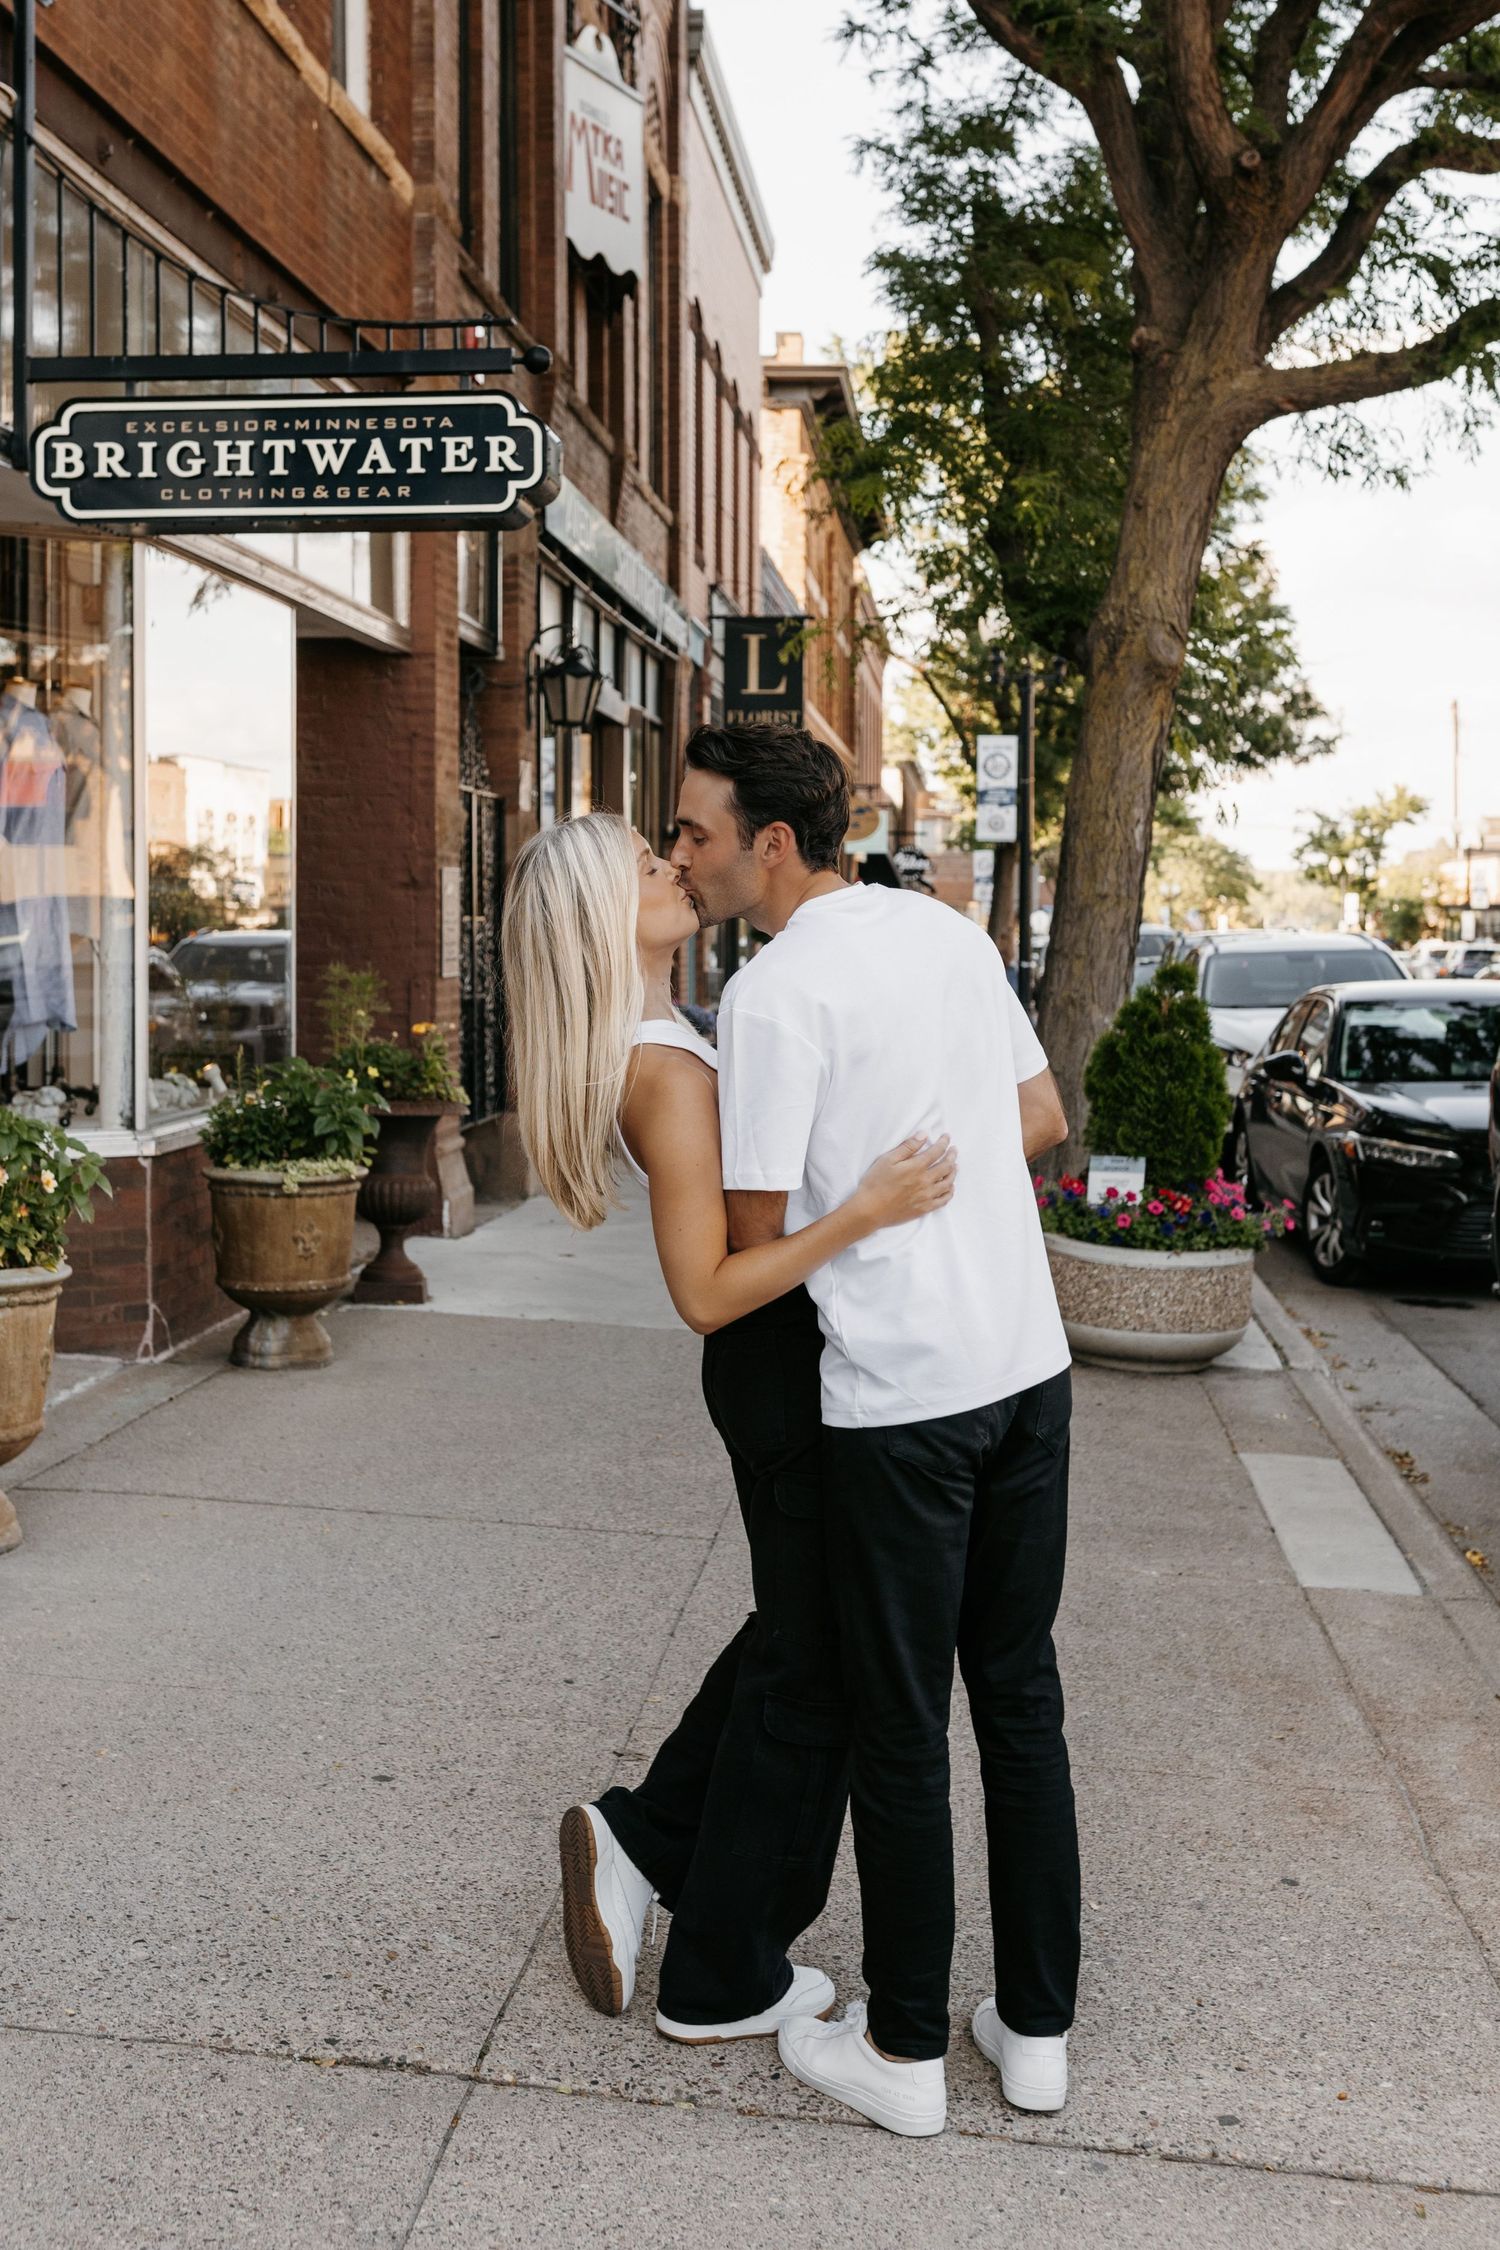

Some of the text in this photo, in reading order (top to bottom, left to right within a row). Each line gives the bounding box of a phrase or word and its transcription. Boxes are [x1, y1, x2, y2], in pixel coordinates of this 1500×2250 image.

[126, 416, 454, 434] EXCELSIOR MINNESOTA
[50, 434, 524, 479] BRIGHTWATER
[741, 633, 788, 695] L
